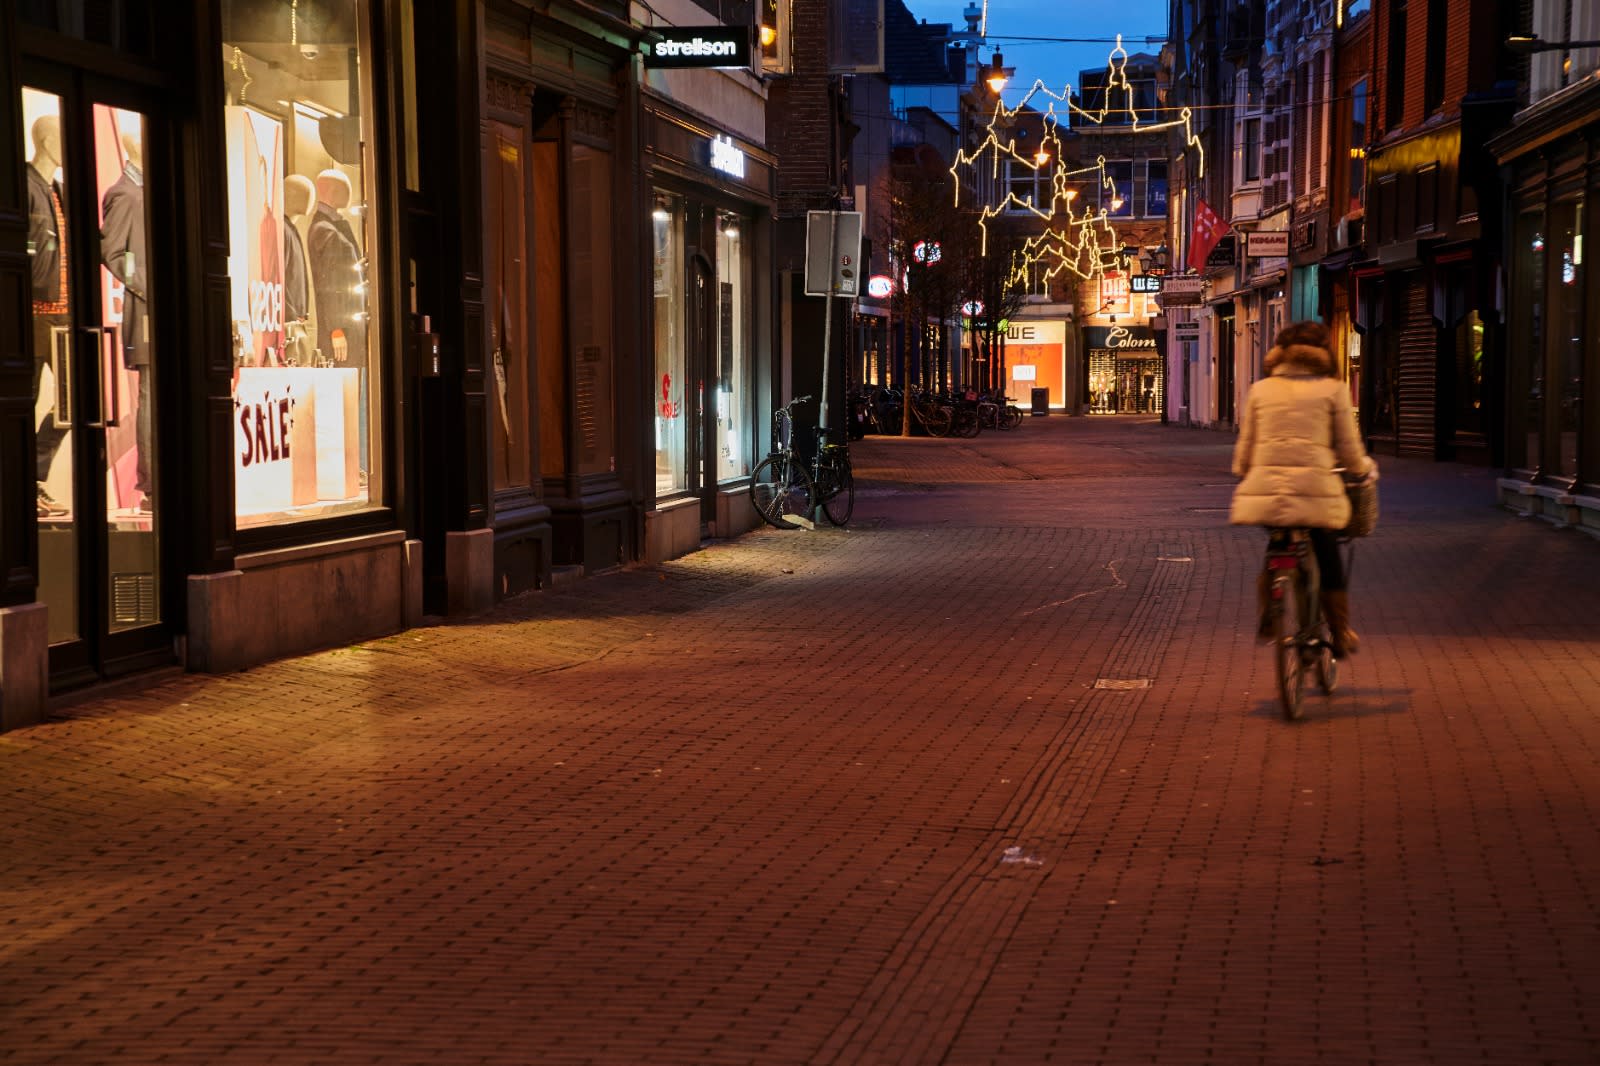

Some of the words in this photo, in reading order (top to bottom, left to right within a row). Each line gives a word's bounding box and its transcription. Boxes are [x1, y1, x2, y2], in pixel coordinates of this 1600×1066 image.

[655, 38, 736, 56] strellson
[1007, 326, 1035, 339] WE
[240, 398, 291, 467] SALE
